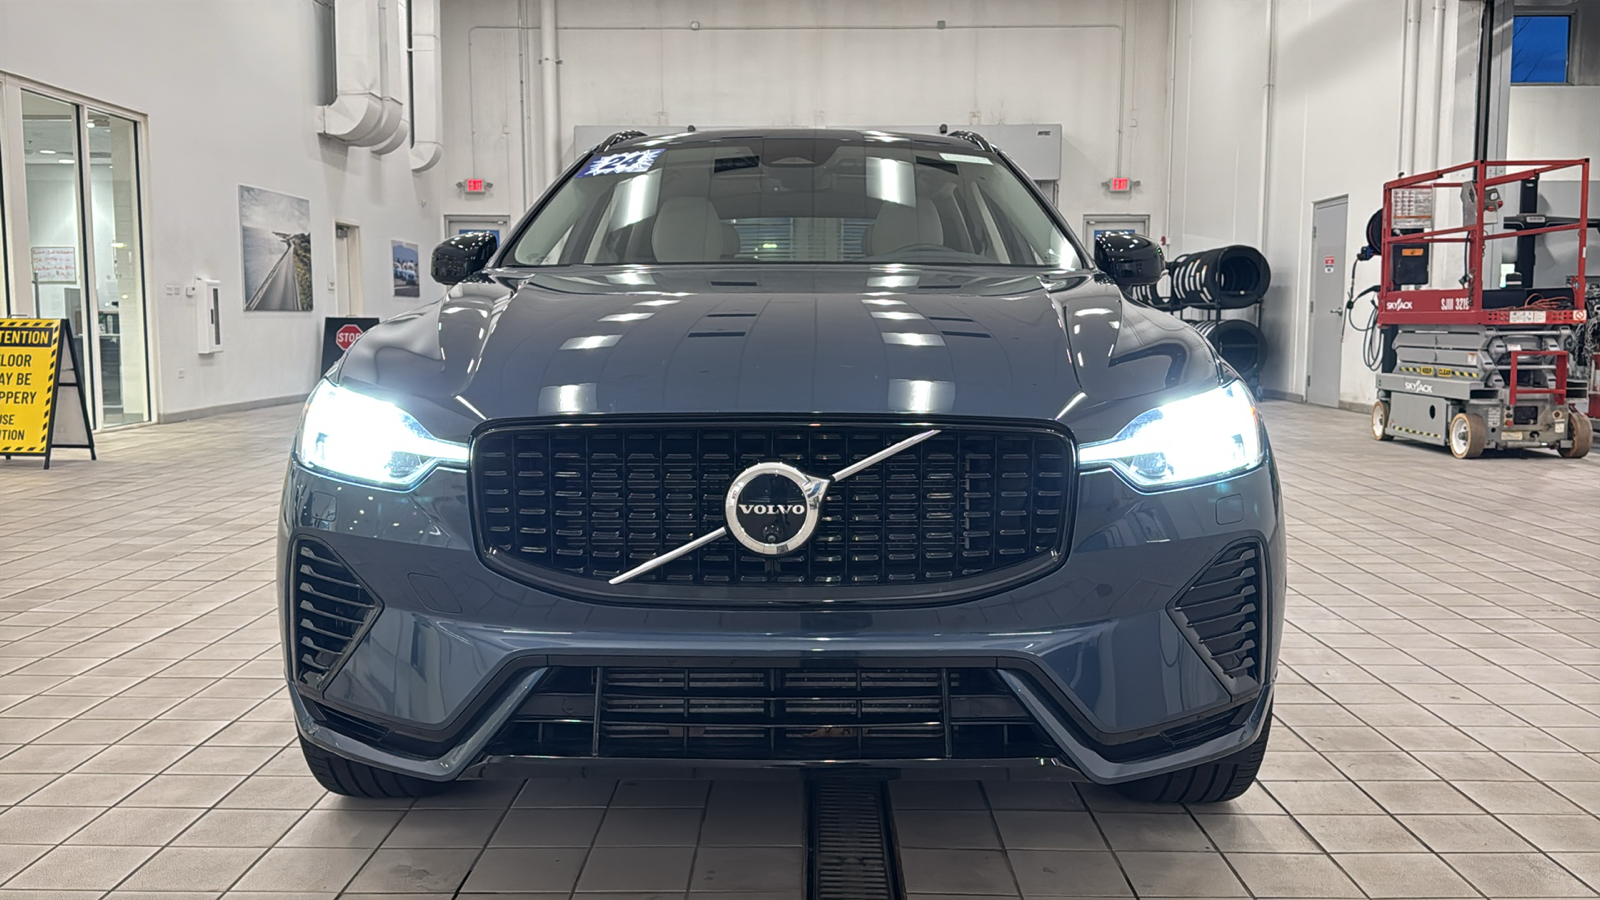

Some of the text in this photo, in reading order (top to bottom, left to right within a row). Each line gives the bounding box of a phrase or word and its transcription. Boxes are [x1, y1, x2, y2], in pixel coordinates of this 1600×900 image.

[599, 153, 644, 170] 24
[467, 179, 482, 191] EXIT
[1112, 177, 1128, 190] EXIT
[1386, 298, 1413, 311] SKYJACK
[0, 354, 32, 367] LOOR
[16, 373, 32, 386] BE
[1405, 380, 1433, 393] SKYJACK
[0, 429, 25, 441] TION
[738, 504, 805, 515] VOLVO
